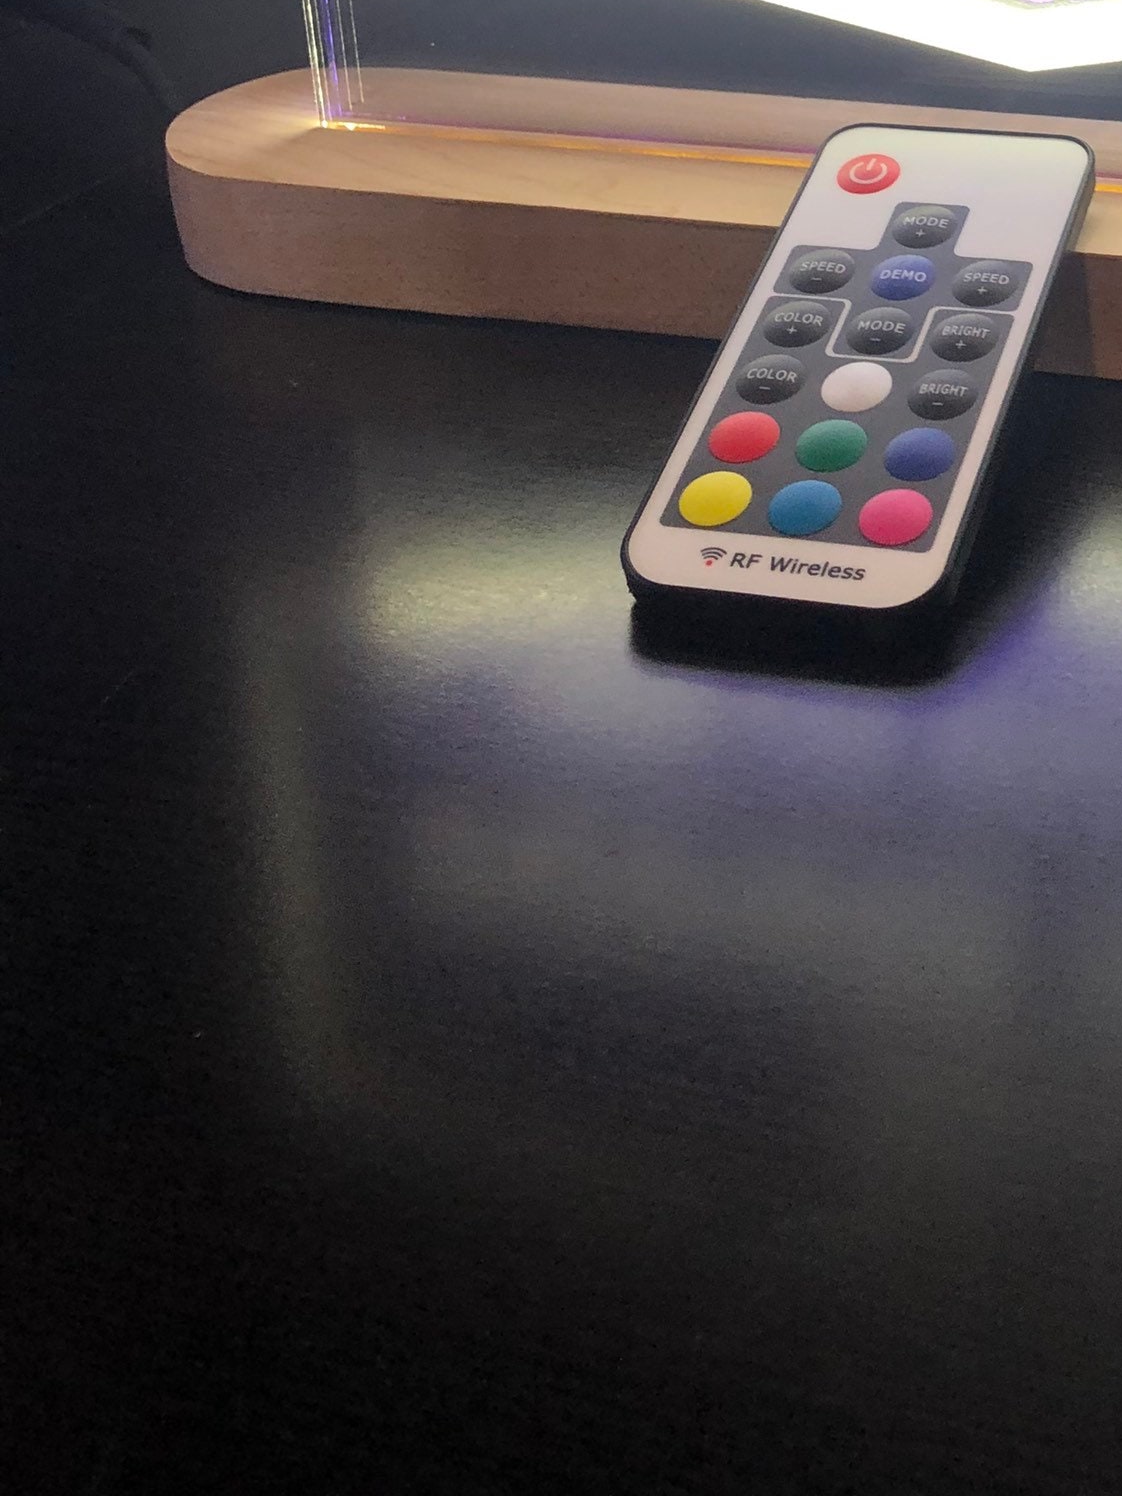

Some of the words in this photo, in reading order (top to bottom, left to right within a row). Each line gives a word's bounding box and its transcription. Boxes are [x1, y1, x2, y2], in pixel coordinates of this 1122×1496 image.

[902, 215, 950, 229] MODE
[800, 260, 847, 274] SPEED
[879, 267, 927, 283] DEMO
[963, 271, 1010, 286] SPEED
[774, 312, 824, 327] COLOR
[858, 319, 906, 334] MODE
[941, 324, 990, 340] BRIGHT
[746, 367, 797, 383] COLOR
[919, 382, 968, 398] BRIGHT
[730, 552, 763, 569] RF
[769, 555, 866, 581] Wireless
